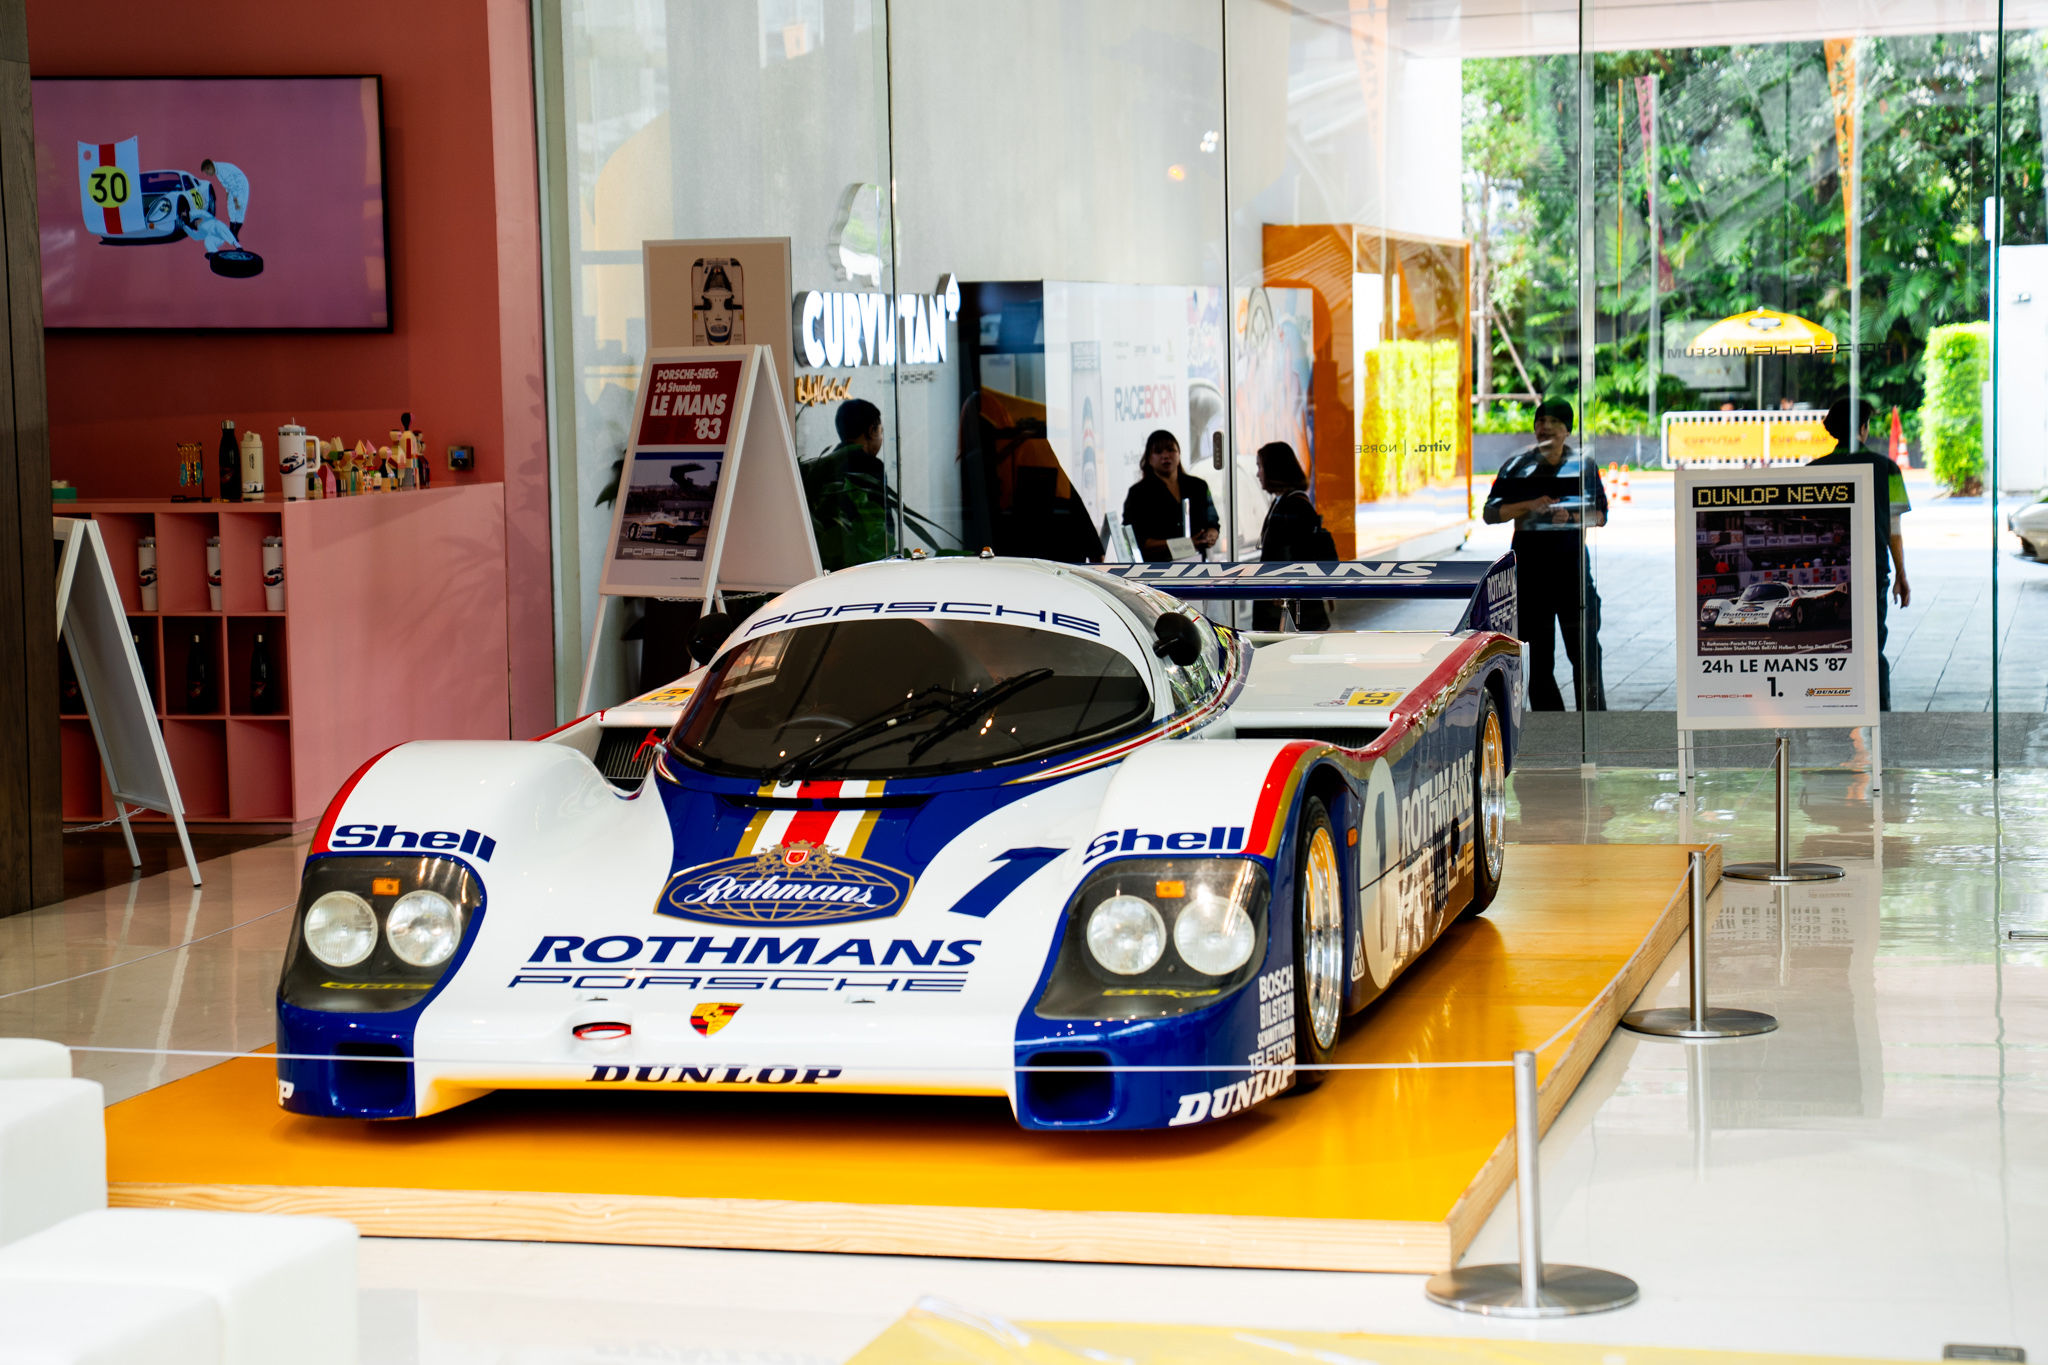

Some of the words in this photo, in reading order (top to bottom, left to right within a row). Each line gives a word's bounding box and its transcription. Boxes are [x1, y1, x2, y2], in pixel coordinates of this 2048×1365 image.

[91, 172, 127, 203] 30
[655, 382, 666, 393] 24
[667, 381, 701, 392] Stunden
[657, 368, 718, 380] PORSCHE-SIEG:
[650, 395, 670, 416] LE
[672, 394, 727, 416] MANS
[694, 418, 722, 439] '83
[1698, 487, 1779, 505] DUNLOP
[1787, 485, 1848, 503] NEWS
[622, 547, 697, 557] PORSCHE
[1092, 562, 1437, 578] THMANS
[743, 601, 1100, 637] PORSCHE
[1702, 659, 1733, 673] 24h
[1740, 659, 1758, 673] LE
[1764, 658, 1818, 672] MANS
[1825, 657, 1847, 671] '87
[1767, 677, 1784, 697] 1.
[1402, 750, 1475, 855] ROTHMANS
[332, 825, 497, 863] Shell
[1083, 827, 1245, 865] Shell
[684, 875, 877, 908] Rothmans
[949, 847, 1071, 919] 1
[527, 936, 982, 967] ROTHMANS
[507, 976, 967, 992] PORSCHE
[1259, 964, 1294, 1003] BOSCH
[1260, 992, 1295, 1030] BILSTEIN
[1248, 1034, 1296, 1074] TELETRON
[585, 1064, 843, 1085] DUNLOP
[1168, 1056, 1296, 1127] DUNLOP
